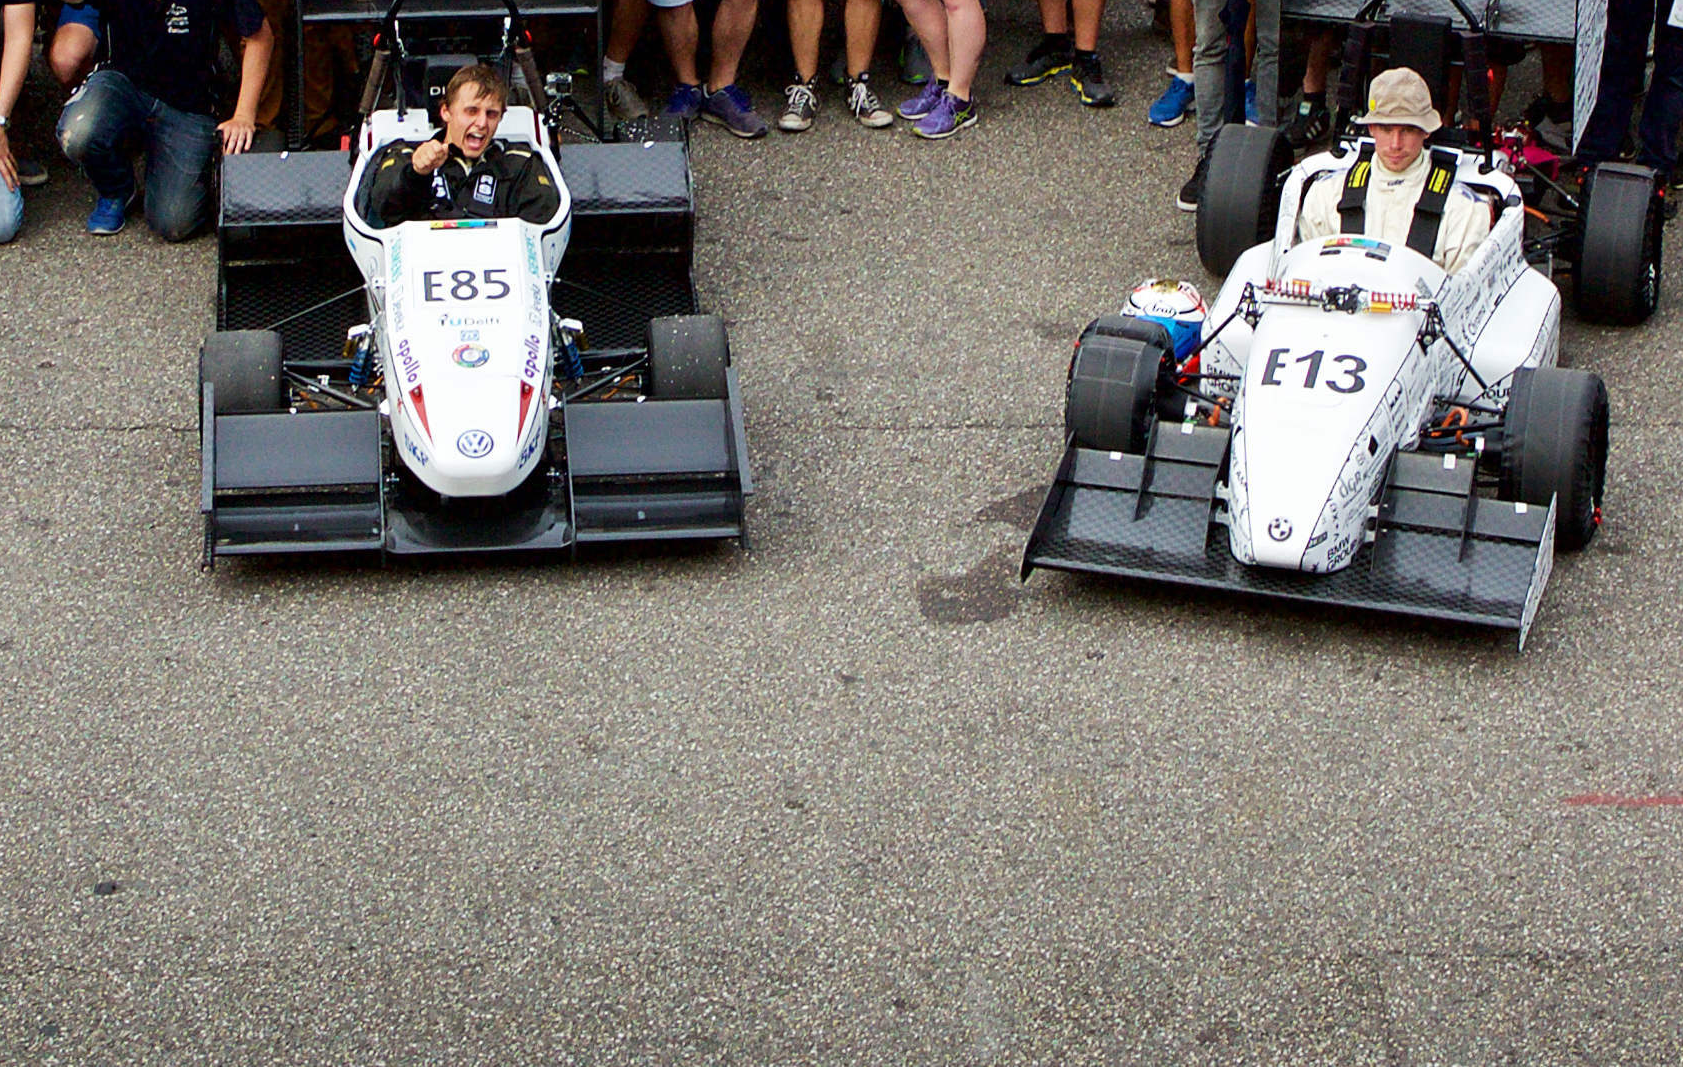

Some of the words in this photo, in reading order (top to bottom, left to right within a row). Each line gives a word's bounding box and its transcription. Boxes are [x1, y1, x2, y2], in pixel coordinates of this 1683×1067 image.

[423, 269, 511, 302] E85
[395, 338, 421, 384] apollo
[523, 333, 541, 380] apollo
[1260, 347, 1368, 394] E13
[1326, 534, 1350, 561] BMW
[1326, 538, 1358, 572] GROUP
